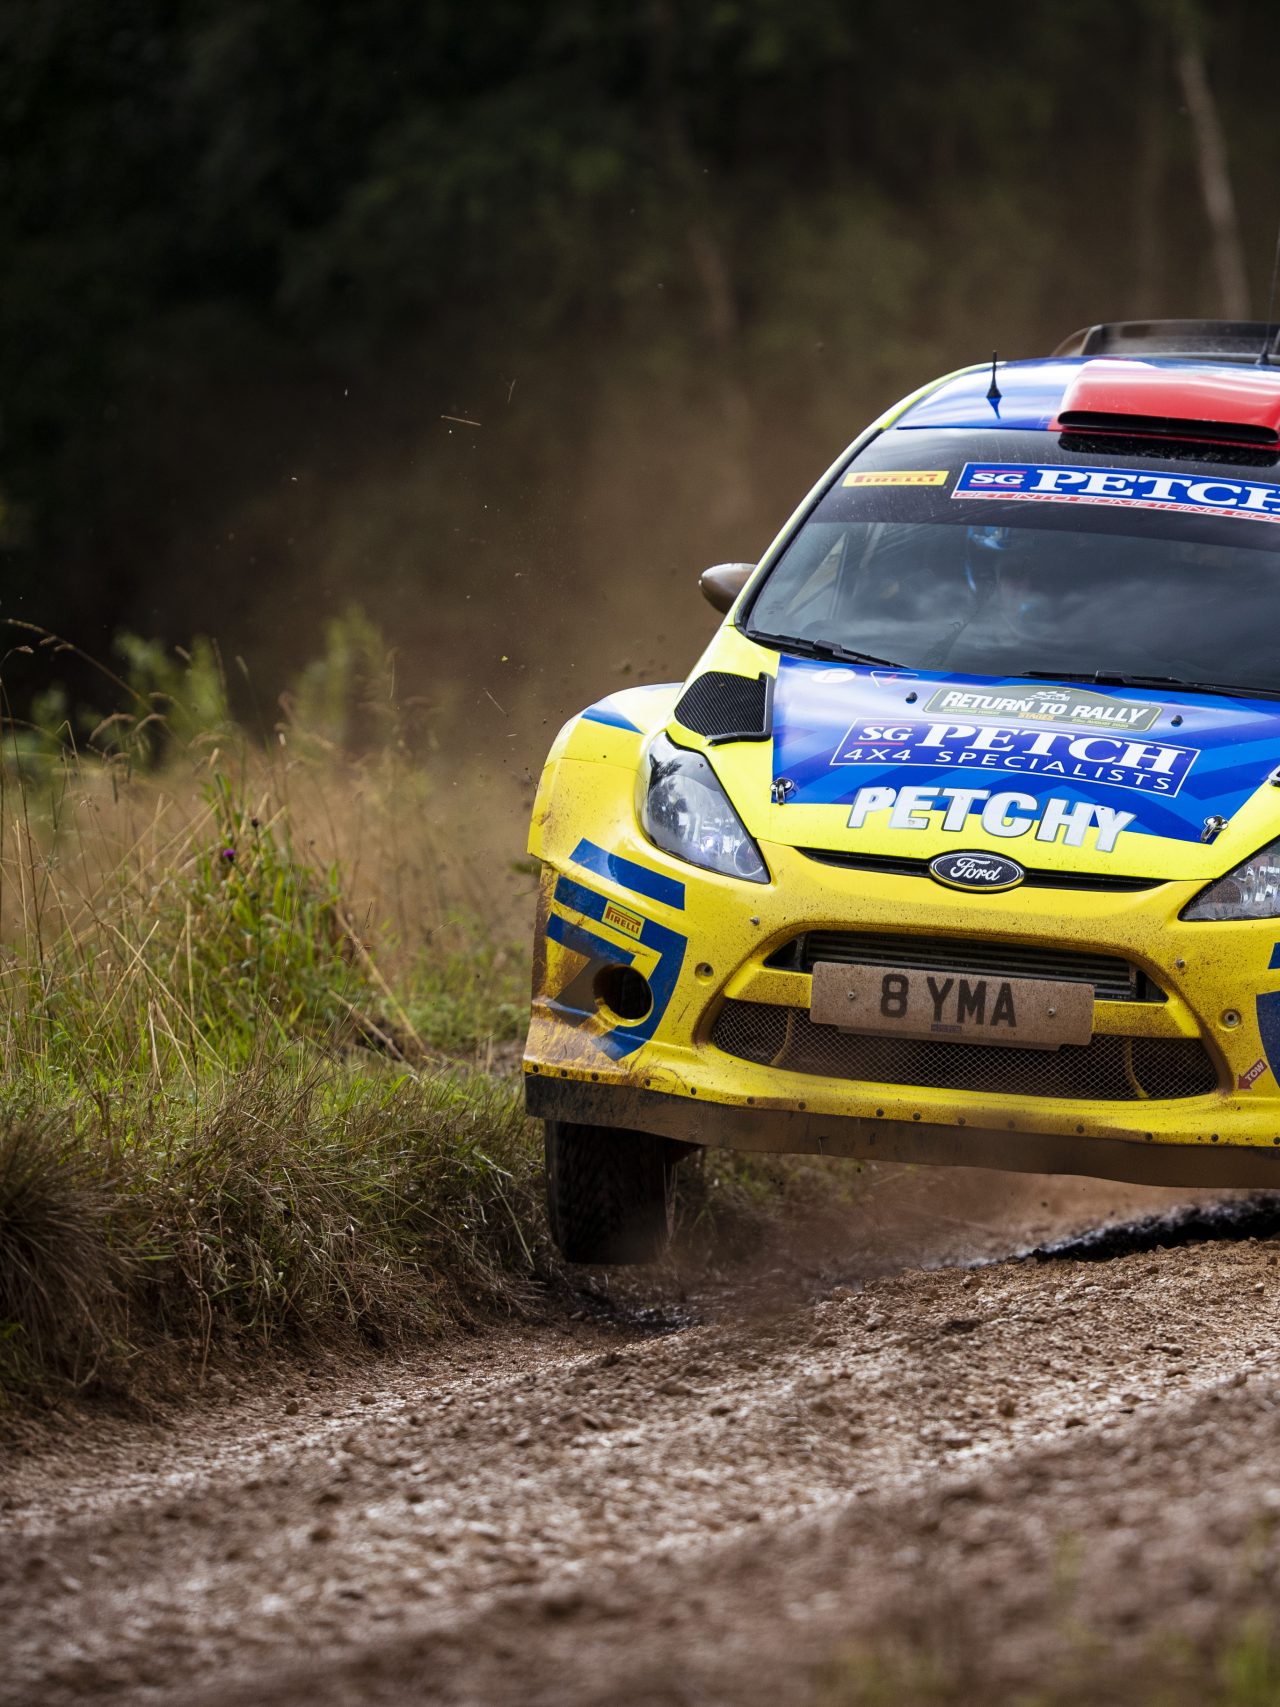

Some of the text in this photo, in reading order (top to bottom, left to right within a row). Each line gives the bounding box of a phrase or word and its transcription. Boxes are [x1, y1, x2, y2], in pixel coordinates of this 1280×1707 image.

[854, 473, 938, 484] PIRELLI
[969, 472, 1025, 485] SG
[940, 690, 1149, 723] RETURN TO RALLY
[858, 723, 1187, 775] SG PETCH
[935, 751, 1171, 790] SPECIALISTS
[846, 785, 1138, 853] PETCHY
[950, 857, 1003, 881] Ford
[604, 905, 642, 935] PIRELLI
[880, 973, 1018, 1028] 8 YMA
[1244, 1061, 1265, 1081] TOW
